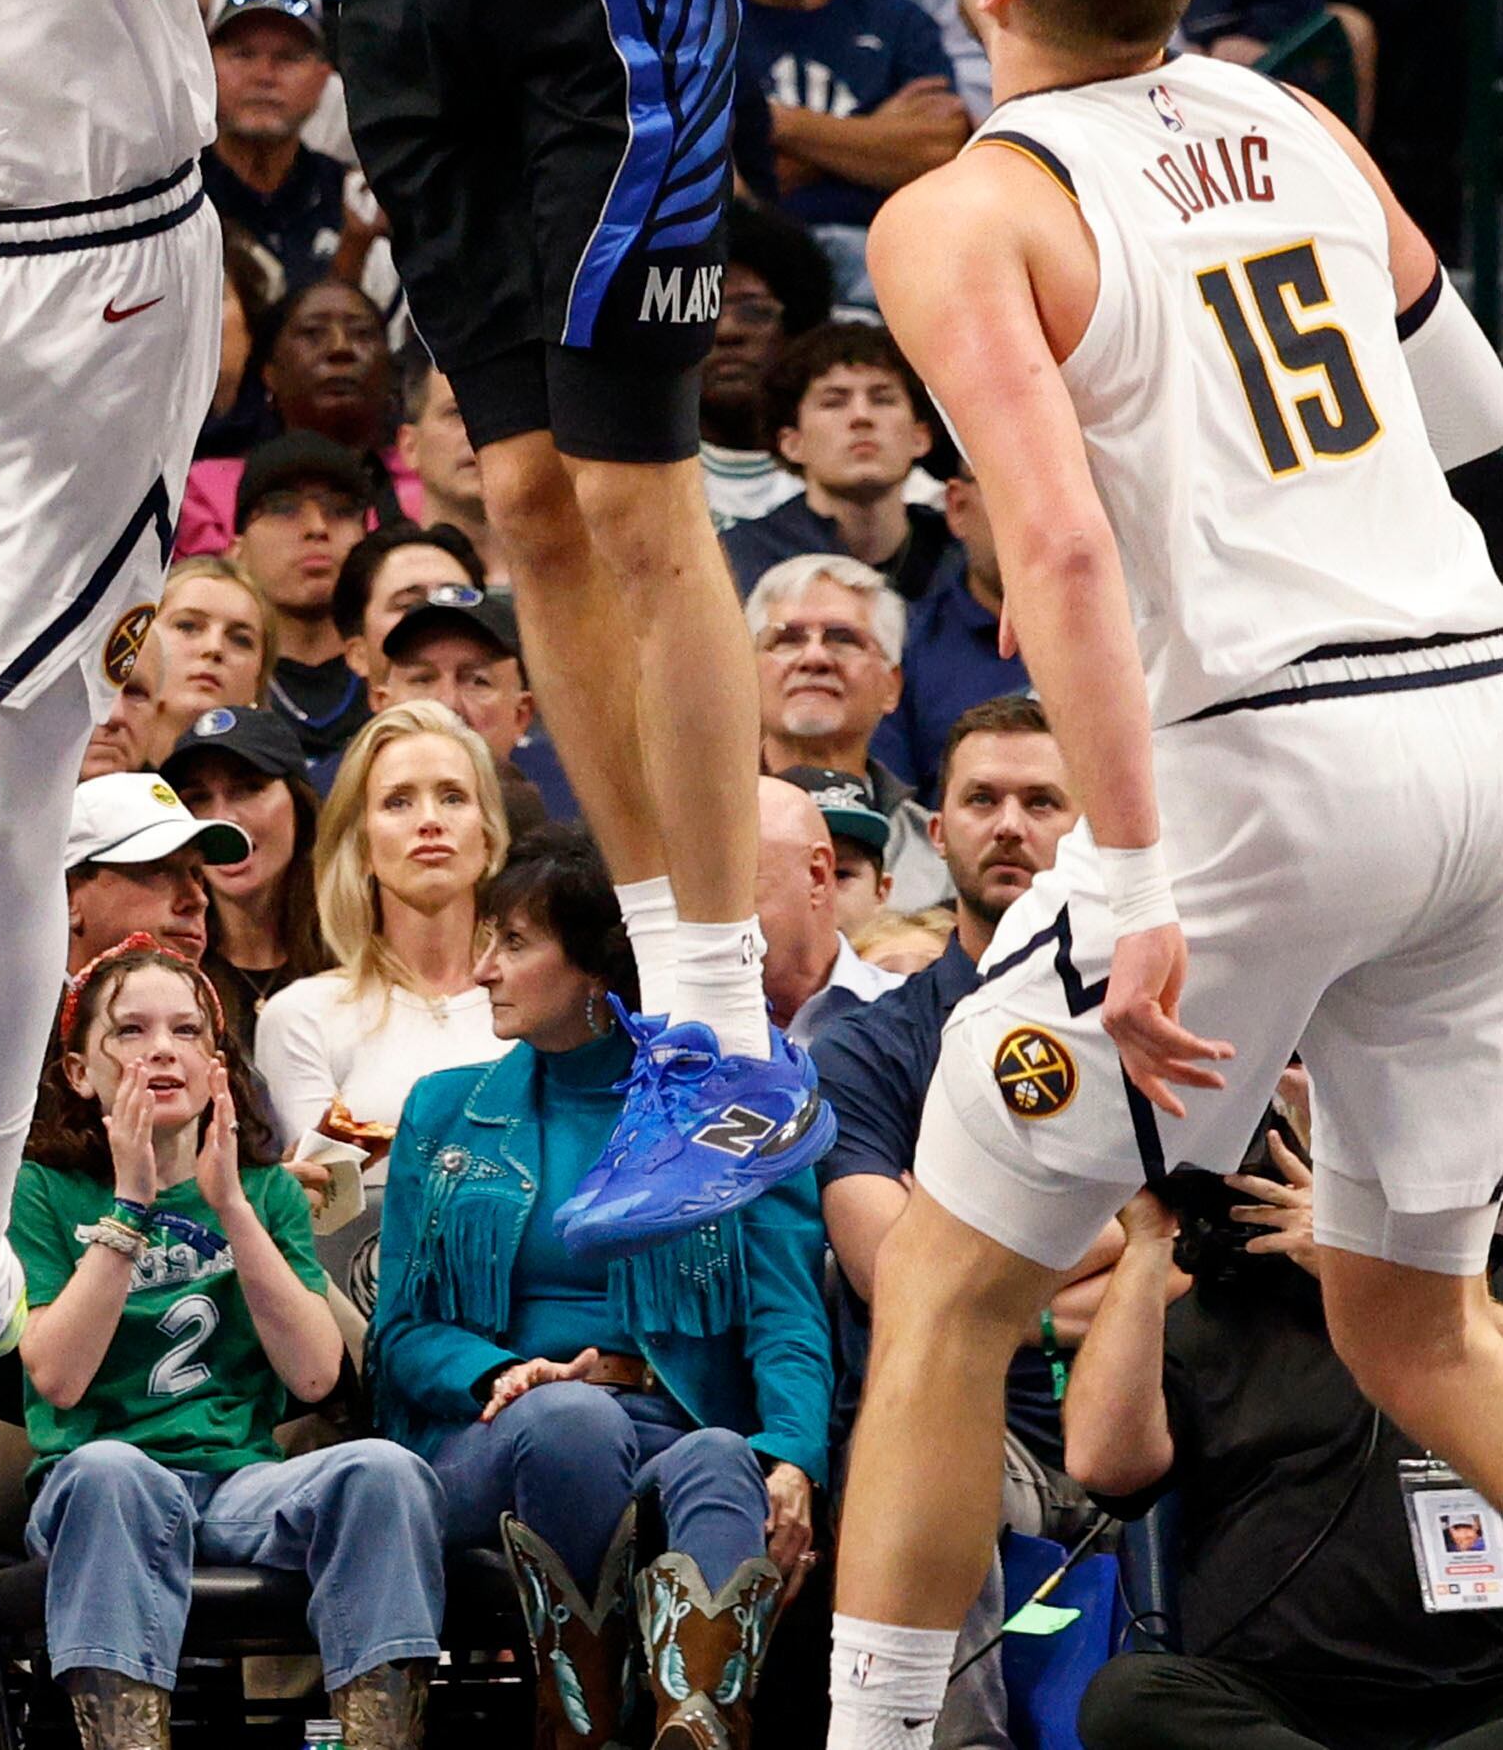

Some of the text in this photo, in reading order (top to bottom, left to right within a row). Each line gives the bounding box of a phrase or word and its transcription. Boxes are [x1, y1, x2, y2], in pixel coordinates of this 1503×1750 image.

[1141, 124, 1276, 225] JOKIĆ
[637, 263, 724, 324] MAVS
[1193, 236, 1387, 482] 15
[690, 1103, 777, 1158] N
[146, 1292, 221, 1399] 2
